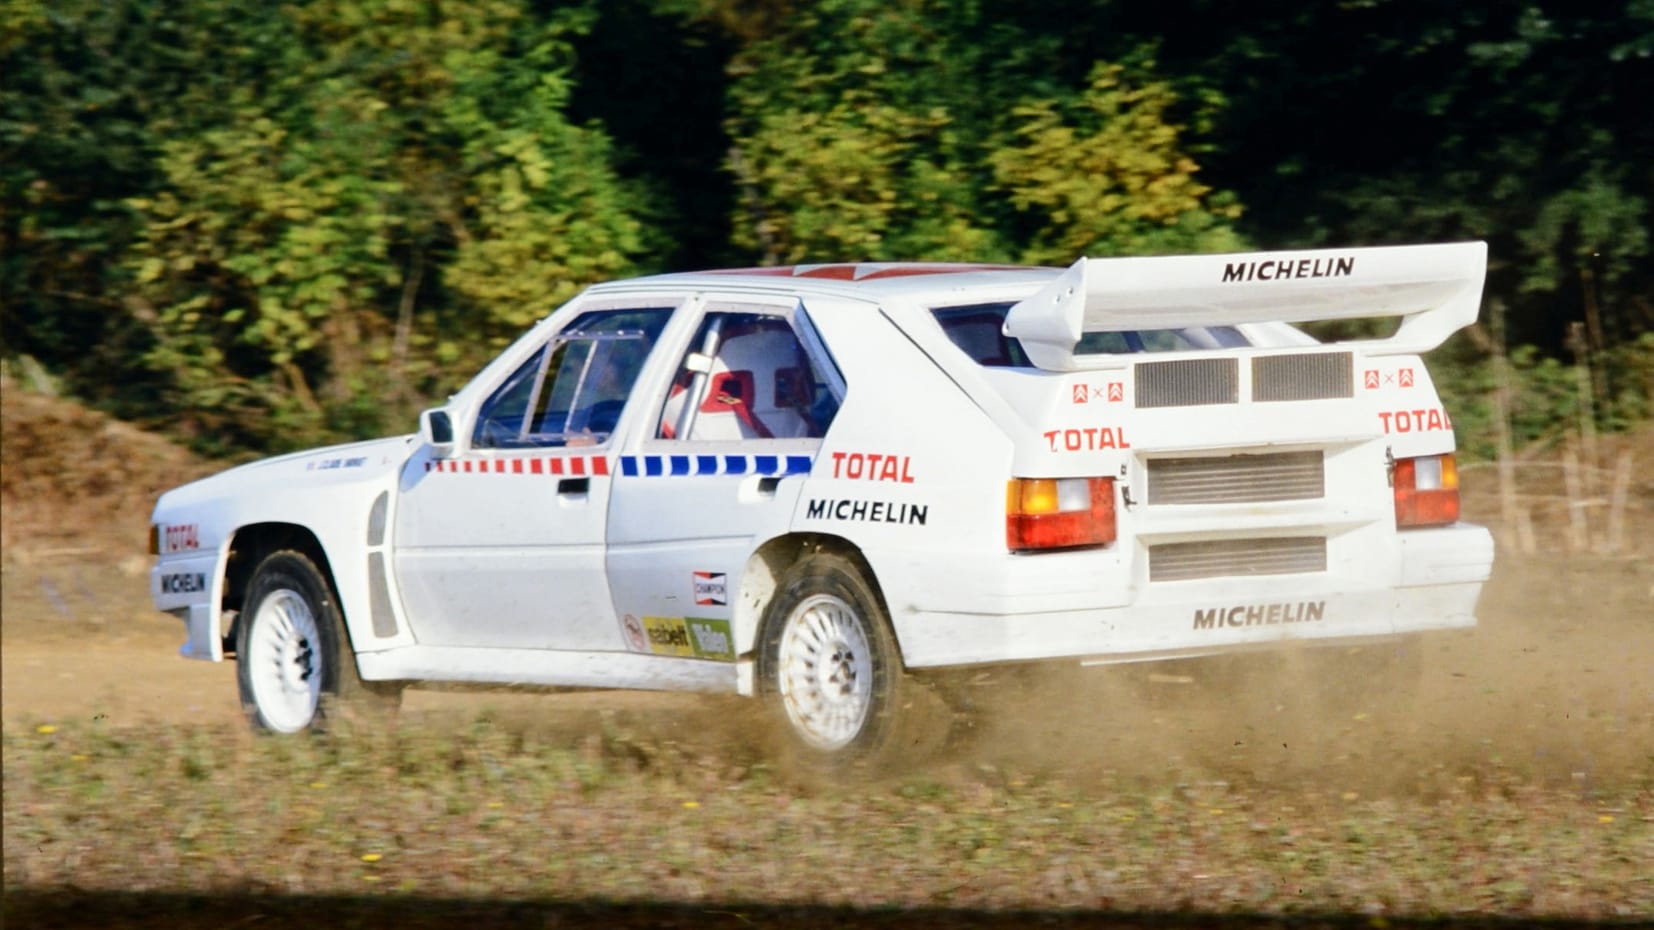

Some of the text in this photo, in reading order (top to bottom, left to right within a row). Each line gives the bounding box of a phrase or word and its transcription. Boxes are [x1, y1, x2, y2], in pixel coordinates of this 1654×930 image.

[1222, 257, 1354, 282] MICHELIN
[1378, 408, 1454, 434] TOTAL
[1043, 427, 1130, 453] TOTAL
[832, 452, 915, 483] TOTAL
[806, 498, 928, 525] MICHELIN
[161, 573, 205, 594] MICHELIN
[1193, 600, 1325, 630] MICHELIN
